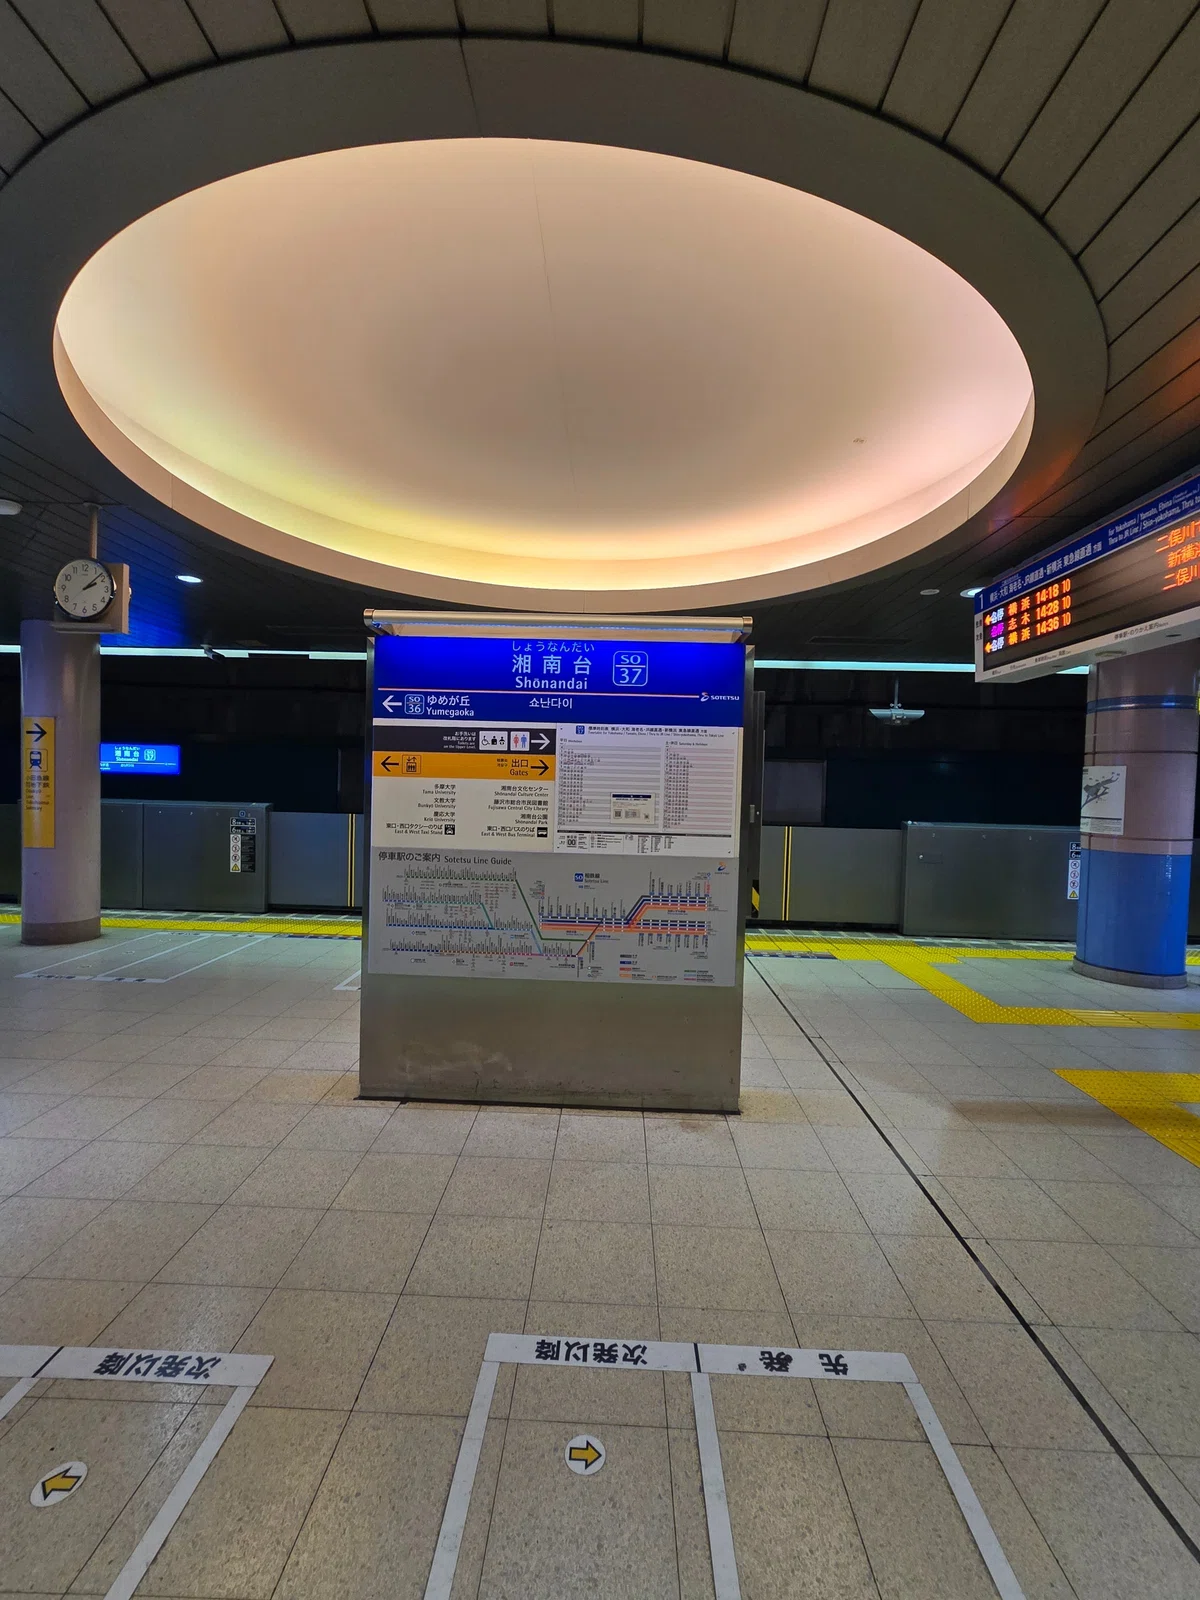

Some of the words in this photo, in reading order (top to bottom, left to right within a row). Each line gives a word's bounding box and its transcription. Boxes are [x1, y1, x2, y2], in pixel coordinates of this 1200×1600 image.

[1156, 521, 1200, 552] 二俣川
[72, 566, 77, 574] 11
[82, 564, 89, 572] 12
[64, 595, 69, 603] 8
[1008, 596, 1030, 616] 横浜
[1036, 584, 1059, 604] 14:18
[1062, 578, 1070, 593] 10
[1008, 612, 1030, 630] 志木
[1036, 600, 1059, 620] 14:28
[1062, 595, 1070, 610] 10
[1008, 627, 1030, 645] 横浜
[1036, 616, 1059, 636] 14:36
[1062, 612, 1070, 626] 10
[512, 641, 595, 652] しょうなんだい
[512, 654, 592, 675] 湘南台
[620, 654, 641, 664] SO
[620, 668, 642, 683] 37
[515, 676, 588, 690] Shōnandai
[427, 695, 470, 706] ゆめが丘
[529, 698, 573, 709] 쇼난다이
[408, 704, 421, 713] 36
[426, 708, 474, 718] Yumegaoka
[512, 759, 528, 767] 出口
[378, 851, 440, 862] 停車駅のご案内
[444, 855, 471, 864] Sotetsu
[474, 856, 488, 864] Line
[491, 857, 512, 865] Guide
[535, 1340, 648, 1365] 次発以降
[93, 1352, 221, 1380] 次発以降
[759, 1350, 848, 1376] 先発
